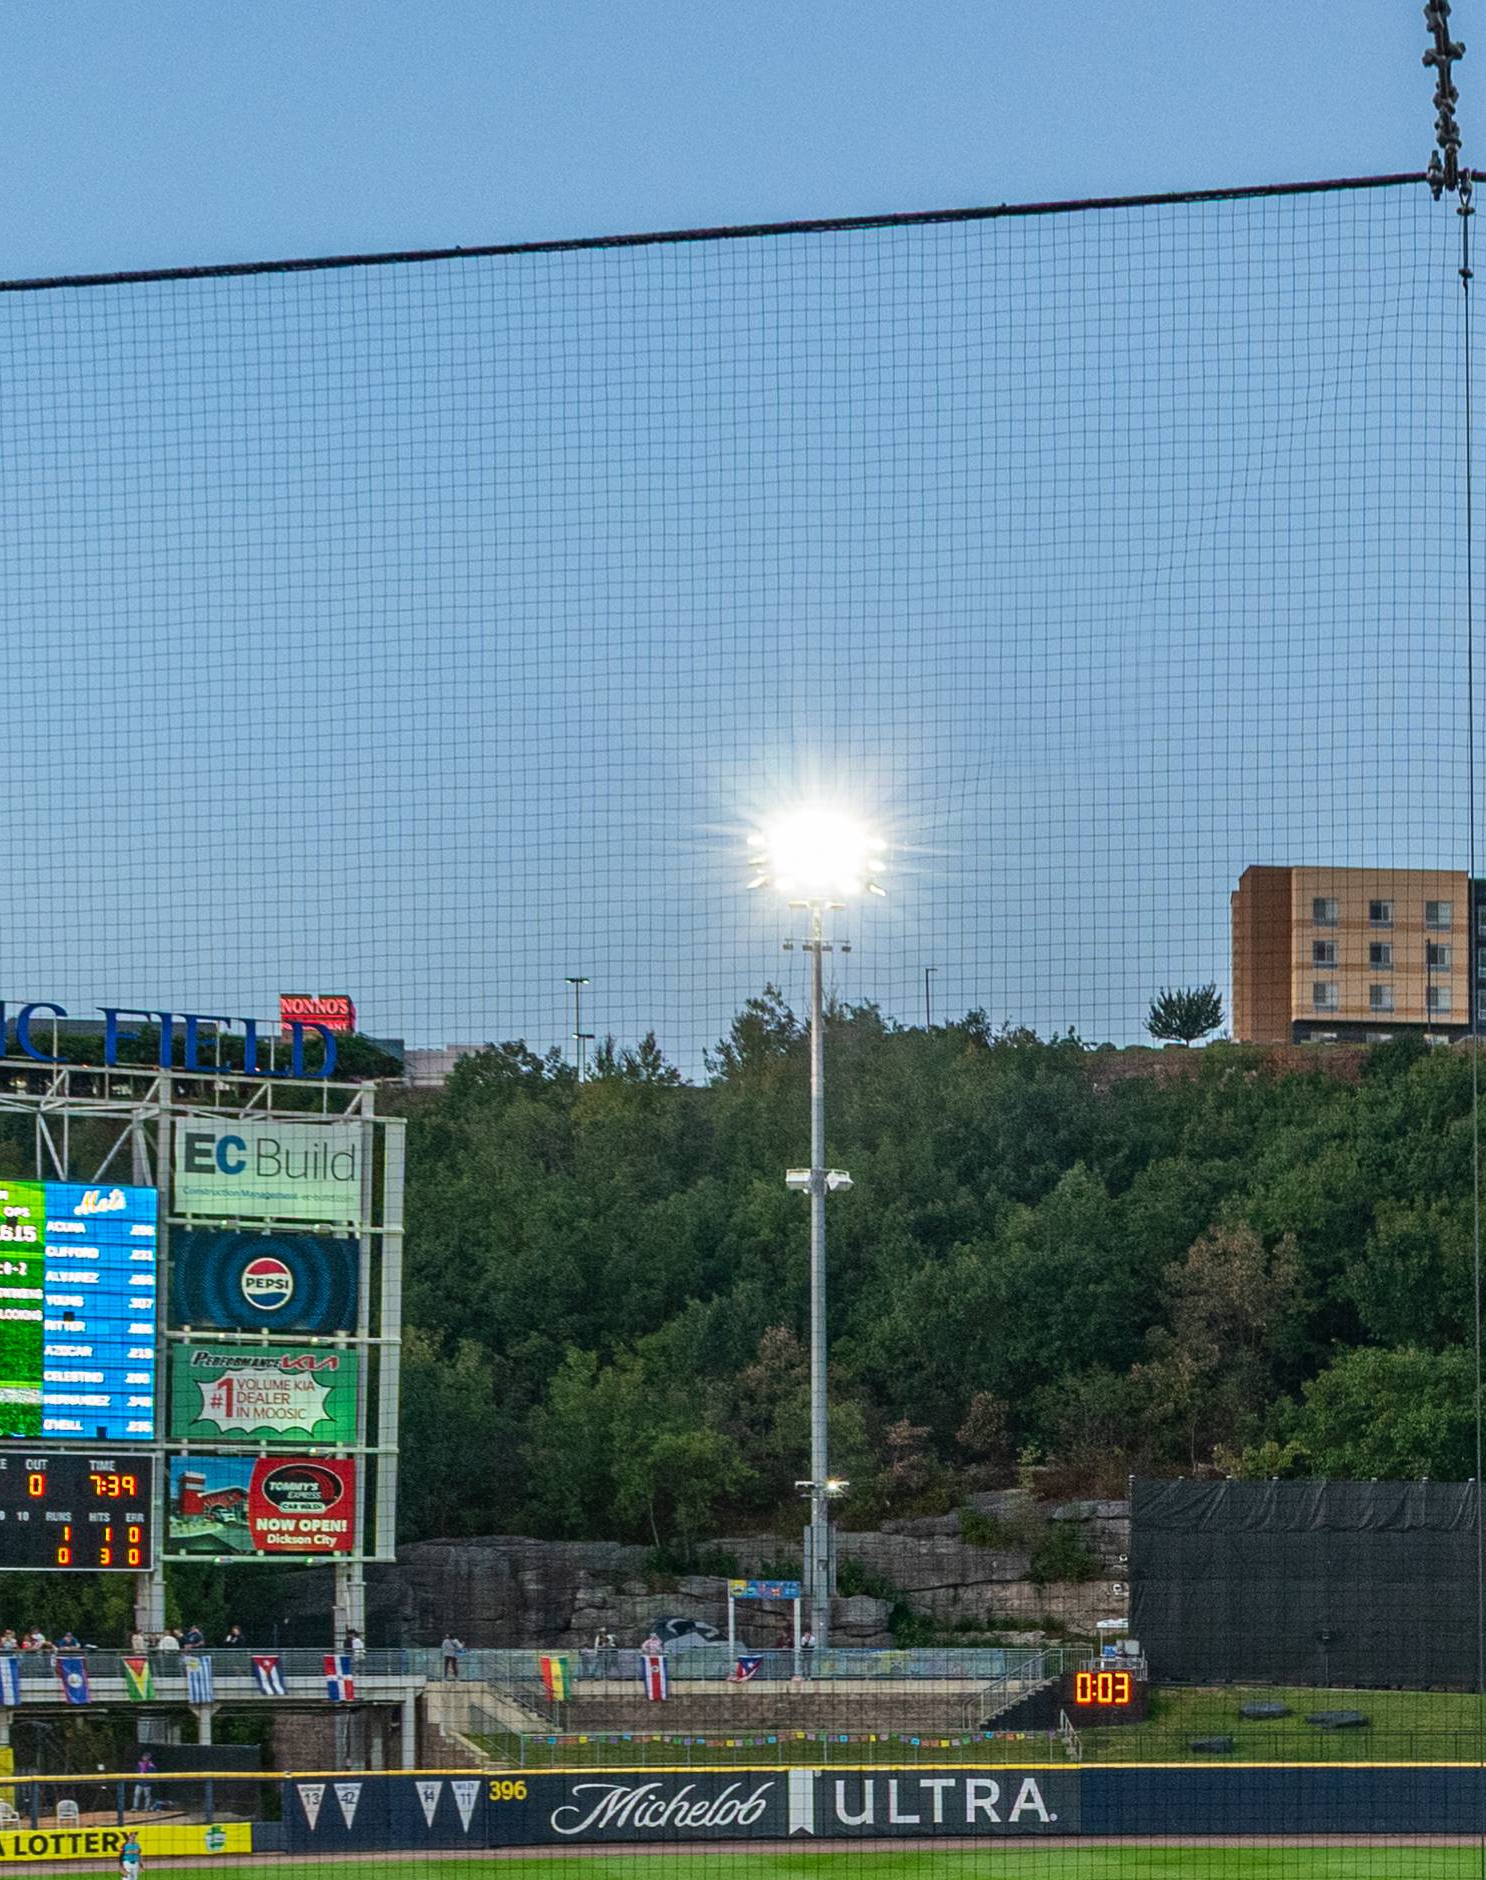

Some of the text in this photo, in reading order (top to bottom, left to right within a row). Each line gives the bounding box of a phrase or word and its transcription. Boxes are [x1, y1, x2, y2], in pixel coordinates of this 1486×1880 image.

[280, 998, 348, 1015] NONNO'S
[96, 1007, 339, 1078] FIELD
[184, 1132, 355, 1182] EC Build
[246, 1277, 289, 1290] PEPSI
[191, 1349, 282, 1369] PERFORMANCE
[210, 1377, 315, 1418] #1 VOLUME KIA
[237, 1391, 291, 1405] DEALER
[237, 1407, 307, 1420] IN MOOSIC
[25, 1459, 49, 1471] OUT
[88, 1460, 116, 1472] TIME
[28, 1474, 45, 1497] 0
[89, 1475, 137, 1497] 7:39
[45, 1511, 145, 1523] RUNS HITS ERR
[256, 1518, 347, 1533] NOW OPEN!
[267, 1533, 337, 1547] Dickson City
[1076, 1671, 1131, 1706] 0:03
[488, 1780, 527, 1801] 396
[550, 1777, 1050, 1835] Michelob ULTRA
[14, 1830, 140, 1856] LOTTERY
